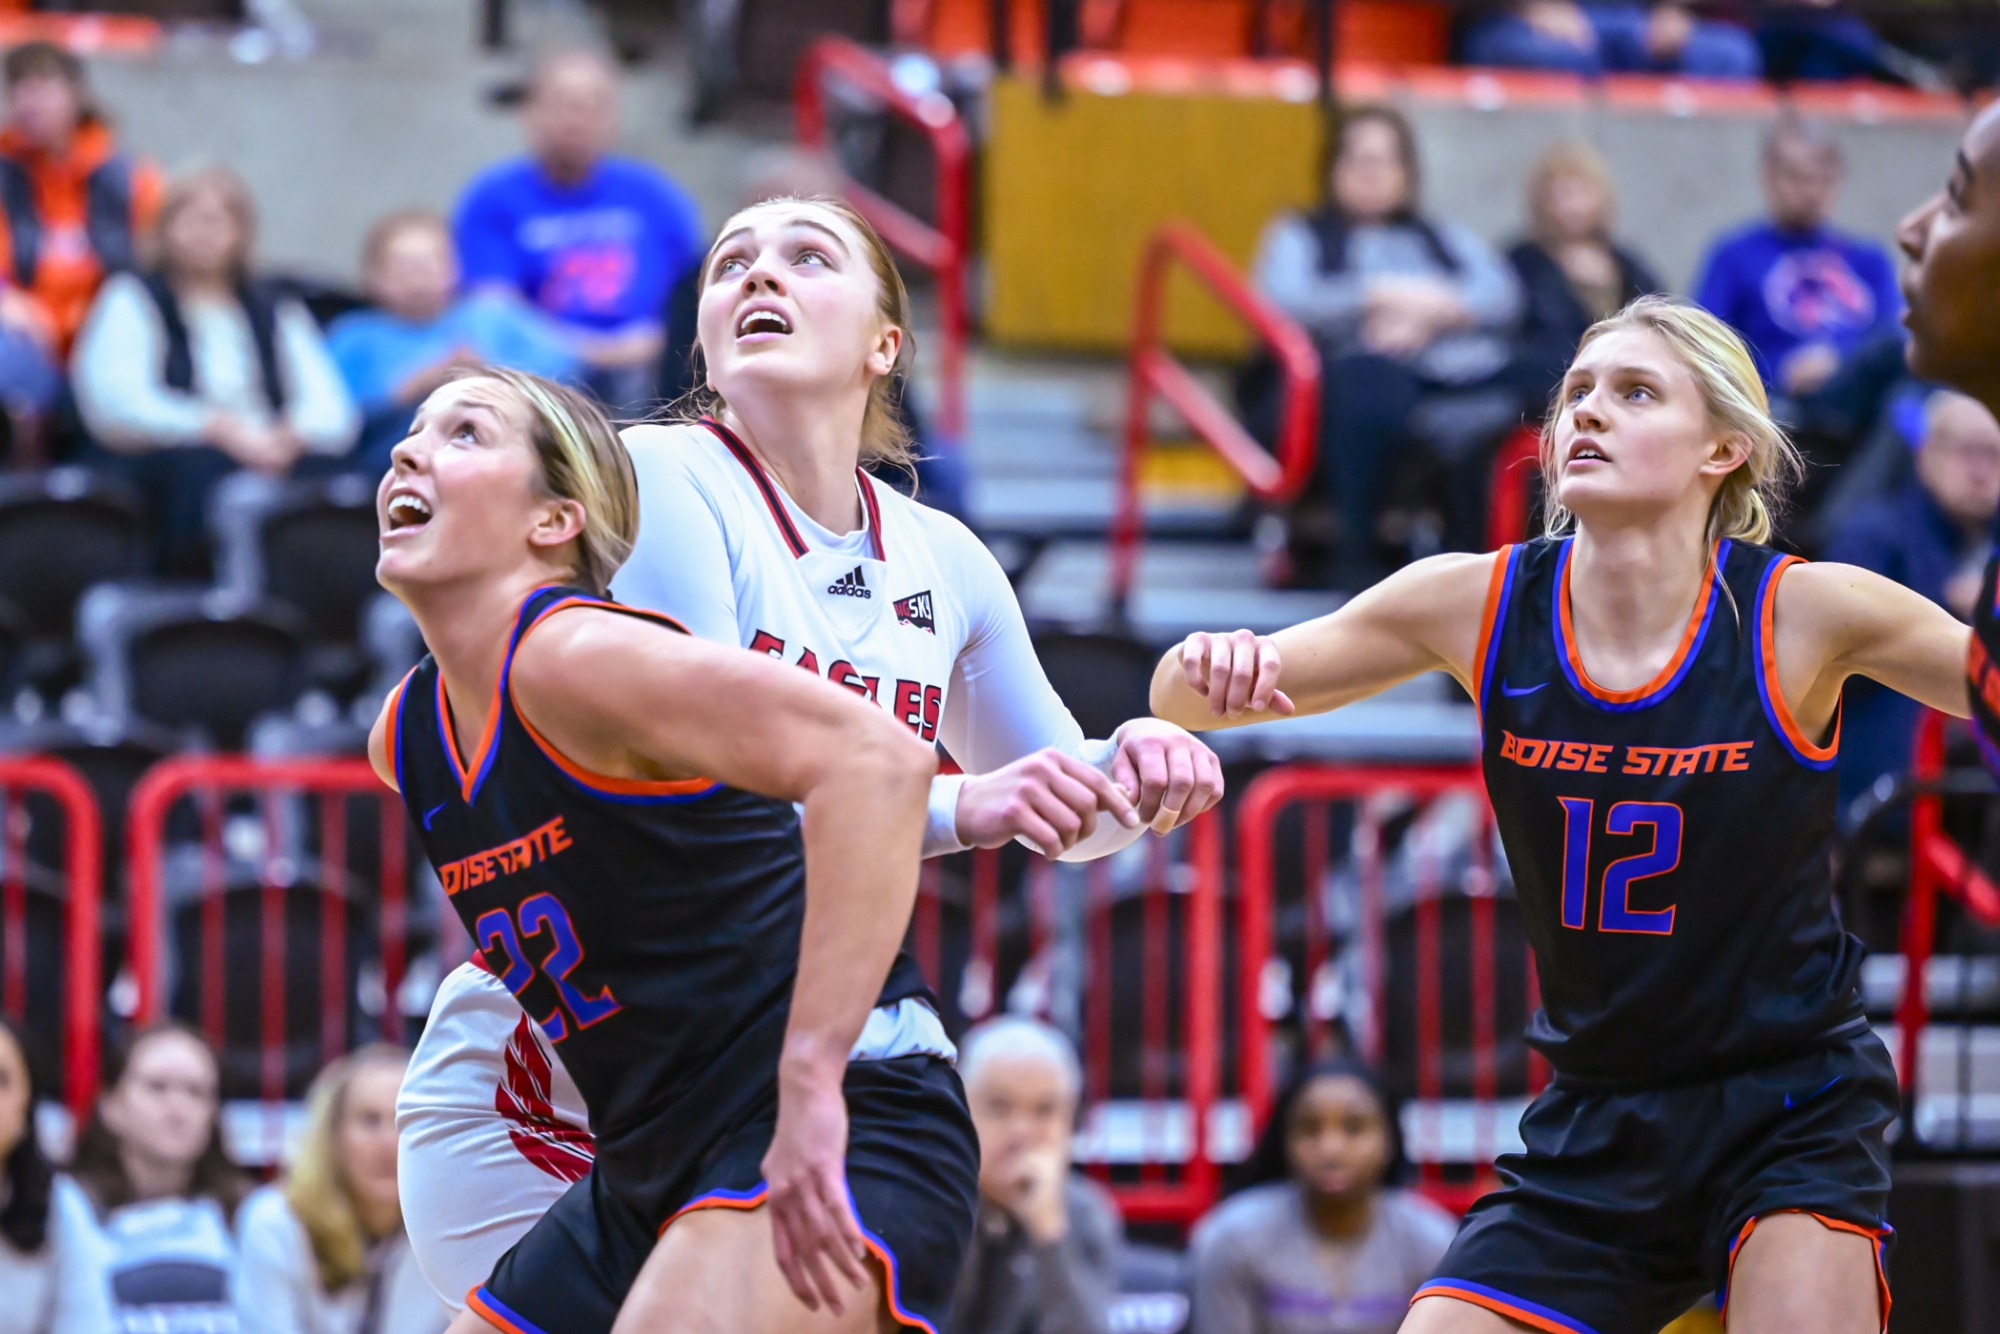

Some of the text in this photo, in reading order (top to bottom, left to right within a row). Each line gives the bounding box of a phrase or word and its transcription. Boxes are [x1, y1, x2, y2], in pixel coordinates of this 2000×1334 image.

[827, 583, 872, 599] adidas
[1501, 729, 1754, 776] BOISE STATE
[438, 849, 497, 896] OISE
[1557, 796, 1683, 935] 12
[476, 891, 624, 1043] 22
